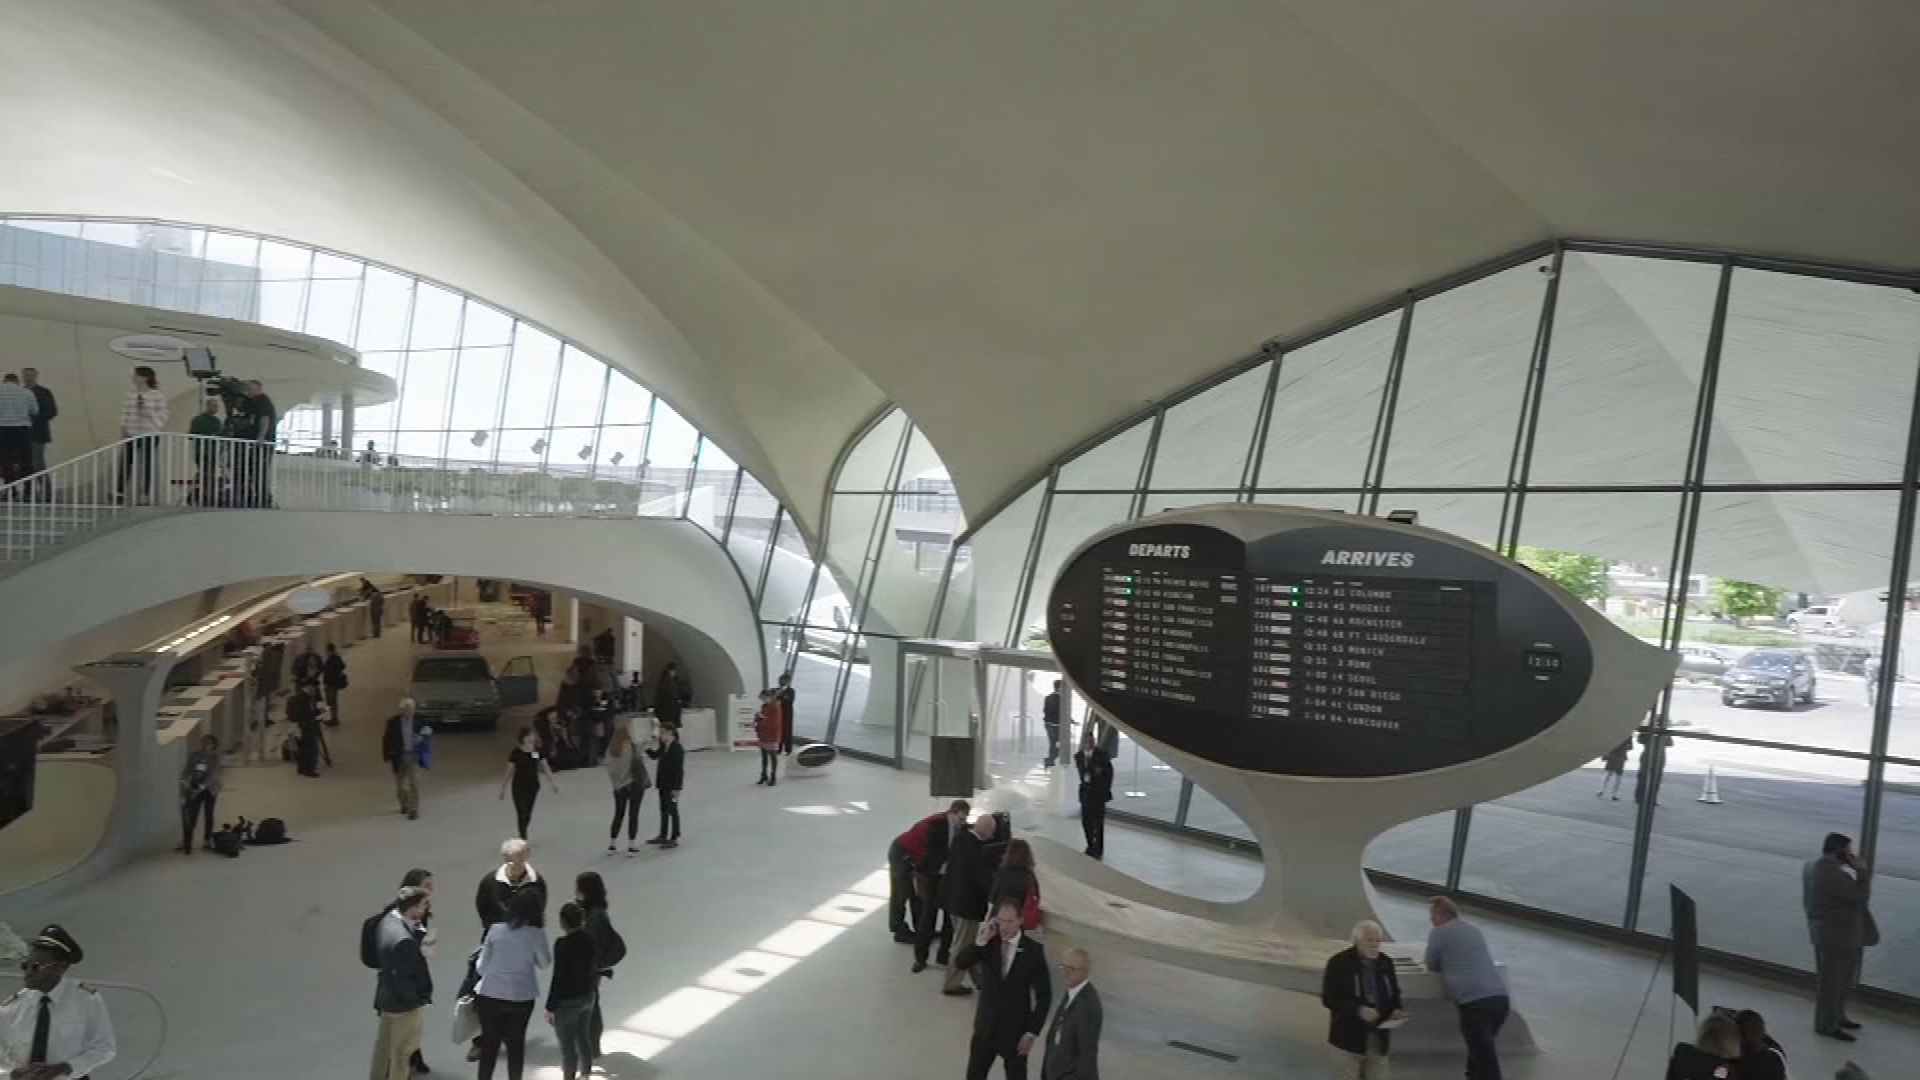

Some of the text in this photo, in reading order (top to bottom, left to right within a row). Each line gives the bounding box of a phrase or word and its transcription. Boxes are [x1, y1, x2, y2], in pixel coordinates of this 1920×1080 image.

[1128, 543, 1191, 559] DEPARTS
[1320, 549, 1416, 569] ARRIVES
[1366, 632, 1427, 645] LAUDERDALE
[1370, 690, 1401, 701] DIEGO
[1347, 701, 1383, 713] LONDON
[1347, 717, 1400, 730] VANCOUVER
